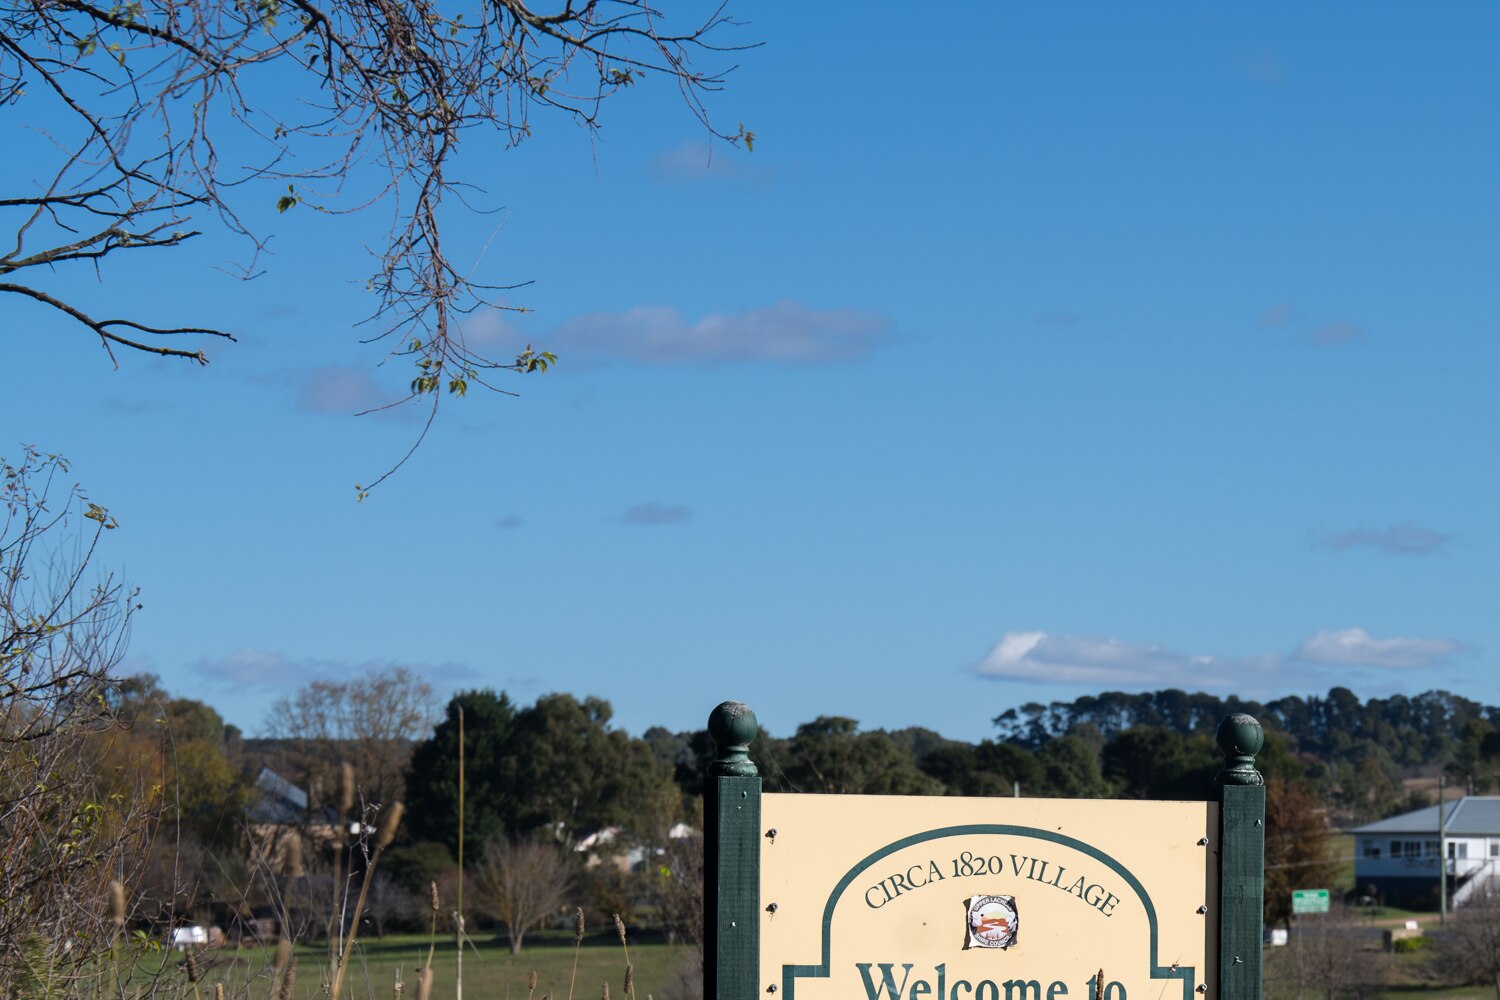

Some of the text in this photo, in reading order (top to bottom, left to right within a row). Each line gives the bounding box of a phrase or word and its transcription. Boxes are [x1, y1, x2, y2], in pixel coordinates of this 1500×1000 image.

[865, 851, 1120, 917] CIRCA 1820 VILLAGE
[973, 898, 990, 911] UPPER
